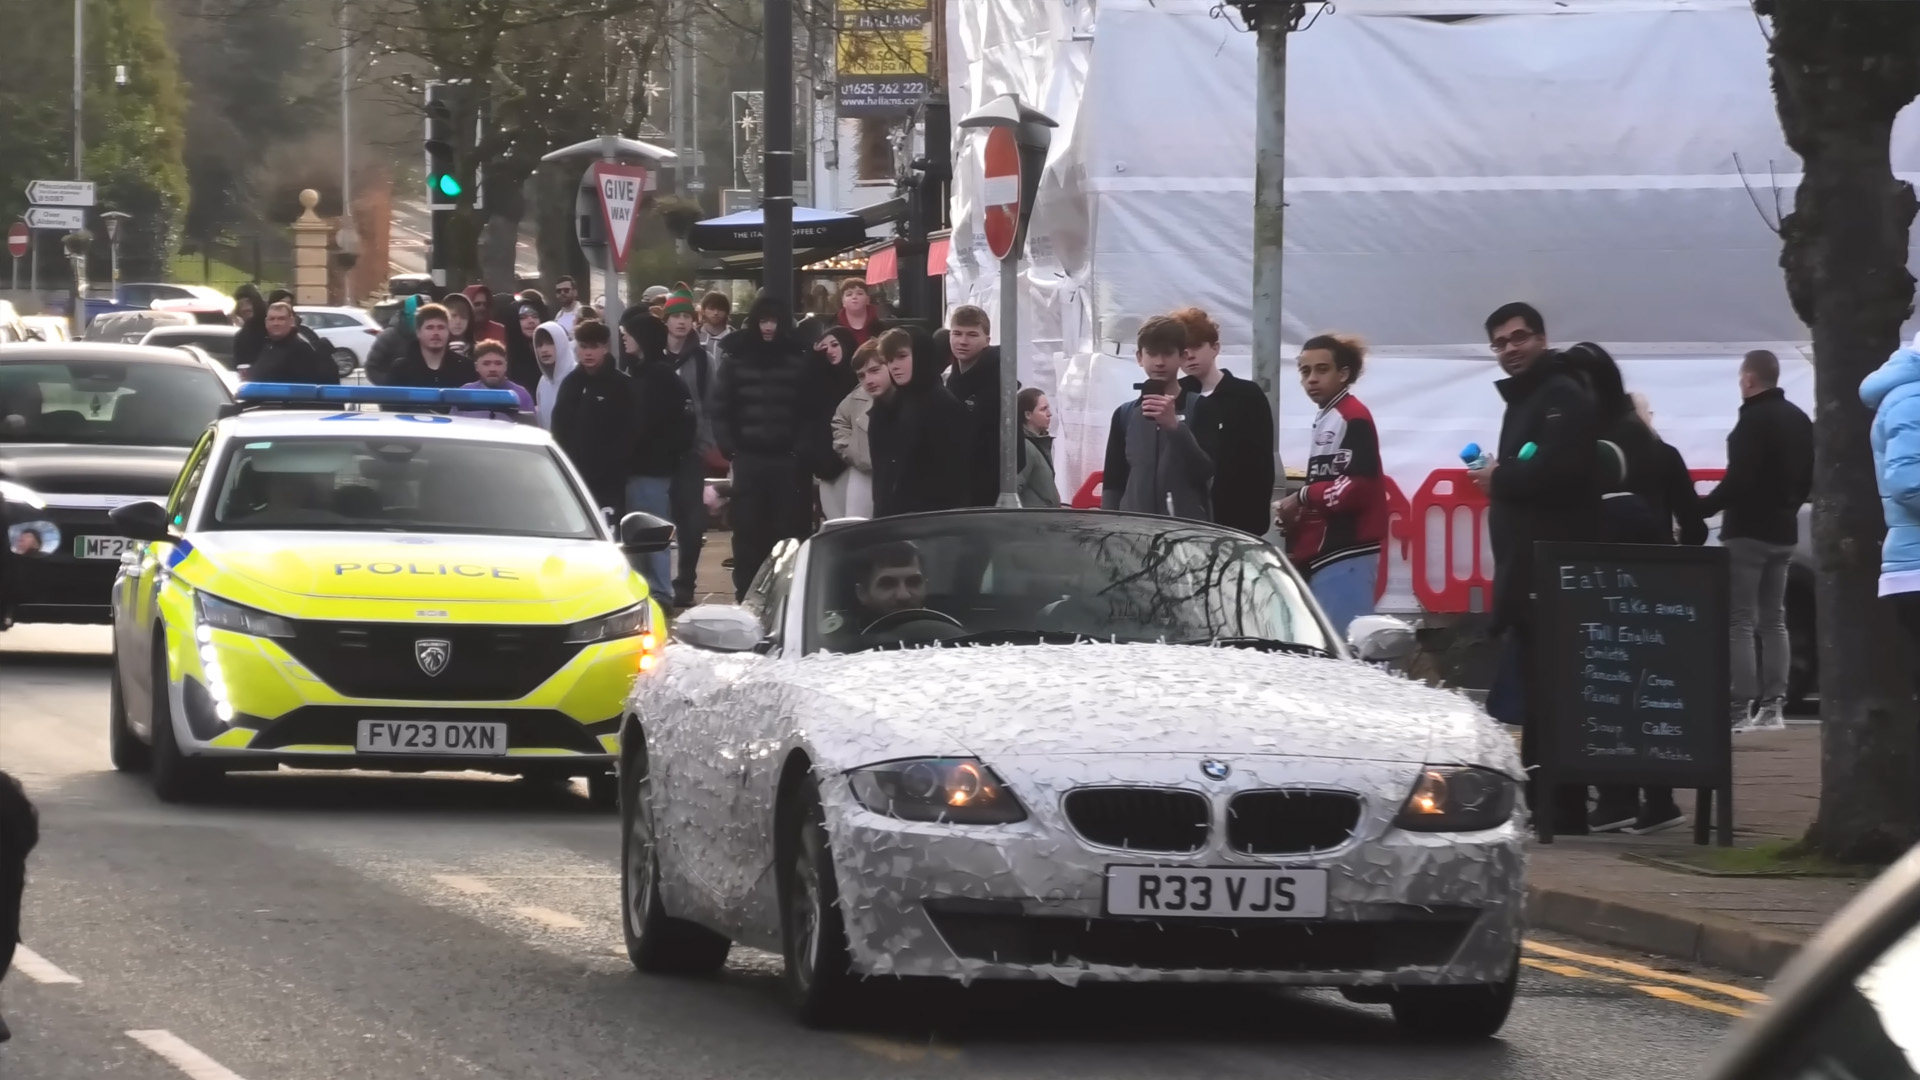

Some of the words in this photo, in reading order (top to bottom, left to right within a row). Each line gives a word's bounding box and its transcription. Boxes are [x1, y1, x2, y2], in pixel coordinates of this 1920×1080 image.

[841, 82, 874, 95] 01625
[878, 82, 899, 95] 262
[902, 82, 924, 95] 222
[604, 178, 634, 202] GIVE
[611, 206, 630, 221] WAY
[733, 231, 749, 239] THE
[334, 563, 520, 580] POLICE
[1560, 565, 1607, 589] Eat
[1616, 568, 1639, 588] in
[1602, 595, 1650, 614] Take
[1655, 603, 1697, 622] away
[1618, 626, 1666, 645] English
[368, 723, 437, 748] FV23
[444, 724, 496, 750] OXN
[1586, 716, 1623, 739] Soup
[1138, 874, 1213, 911] R33
[1224, 876, 1297, 912] VJS
